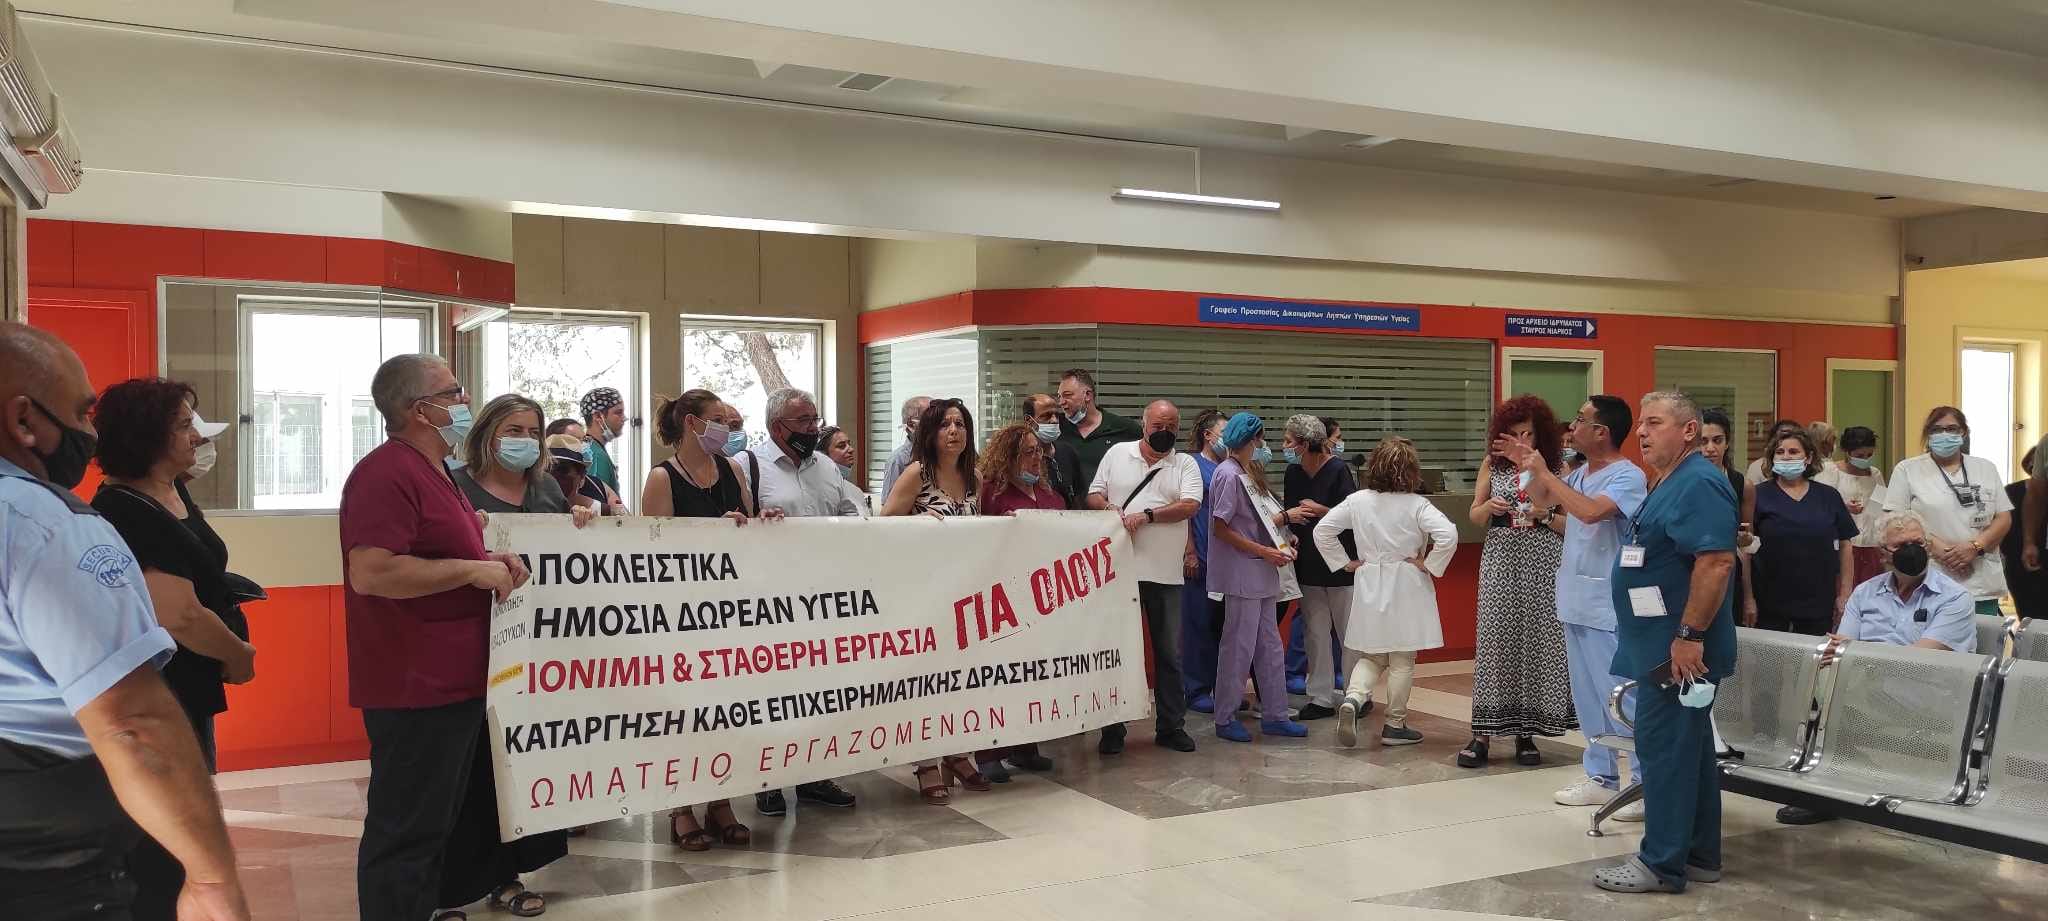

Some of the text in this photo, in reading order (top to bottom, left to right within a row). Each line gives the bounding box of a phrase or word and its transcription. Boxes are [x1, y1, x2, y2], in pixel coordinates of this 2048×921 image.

[1210, 305, 1237, 314] Γραφείο
[1240, 306, 1280, 317] Προστασίας
[1508, 317, 1583, 327] ΠΡΟΣ ΑΡΧΕΙΟ ΙΔΡΥΜΑΤΟΣ
[529, 602, 671, 639] ΗΜΟΣΙΑ
[677, 596, 795, 632] ΔΩΡΕΑΝ
[799, 589, 880, 621] ΥΓΕΙΑ
[953, 536, 1116, 650] ΓΙΑ ΟΛΟΥΣ
[672, 652, 693, 683] &
[699, 638, 828, 680] ΣΤΑΘΕΡΗ
[834, 627, 937, 664] ΕΡΓΑΣΙΑ
[505, 648, 1122, 754] ΚΑΤΑΡΓΗΣΗ ΚΑΘΕ ΕΠΙΧΕΙΡΗΜΑΤΙΚΗΣ ΔΡΑΣΗΣ ΣΤΗΝ ΥΓΕΙΑ
[530, 752, 732, 809] ΩΜΑΤΕΙΟ
[759, 706, 1005, 772] ΕΡΓΑΖΟΜΕΝΩΝ
